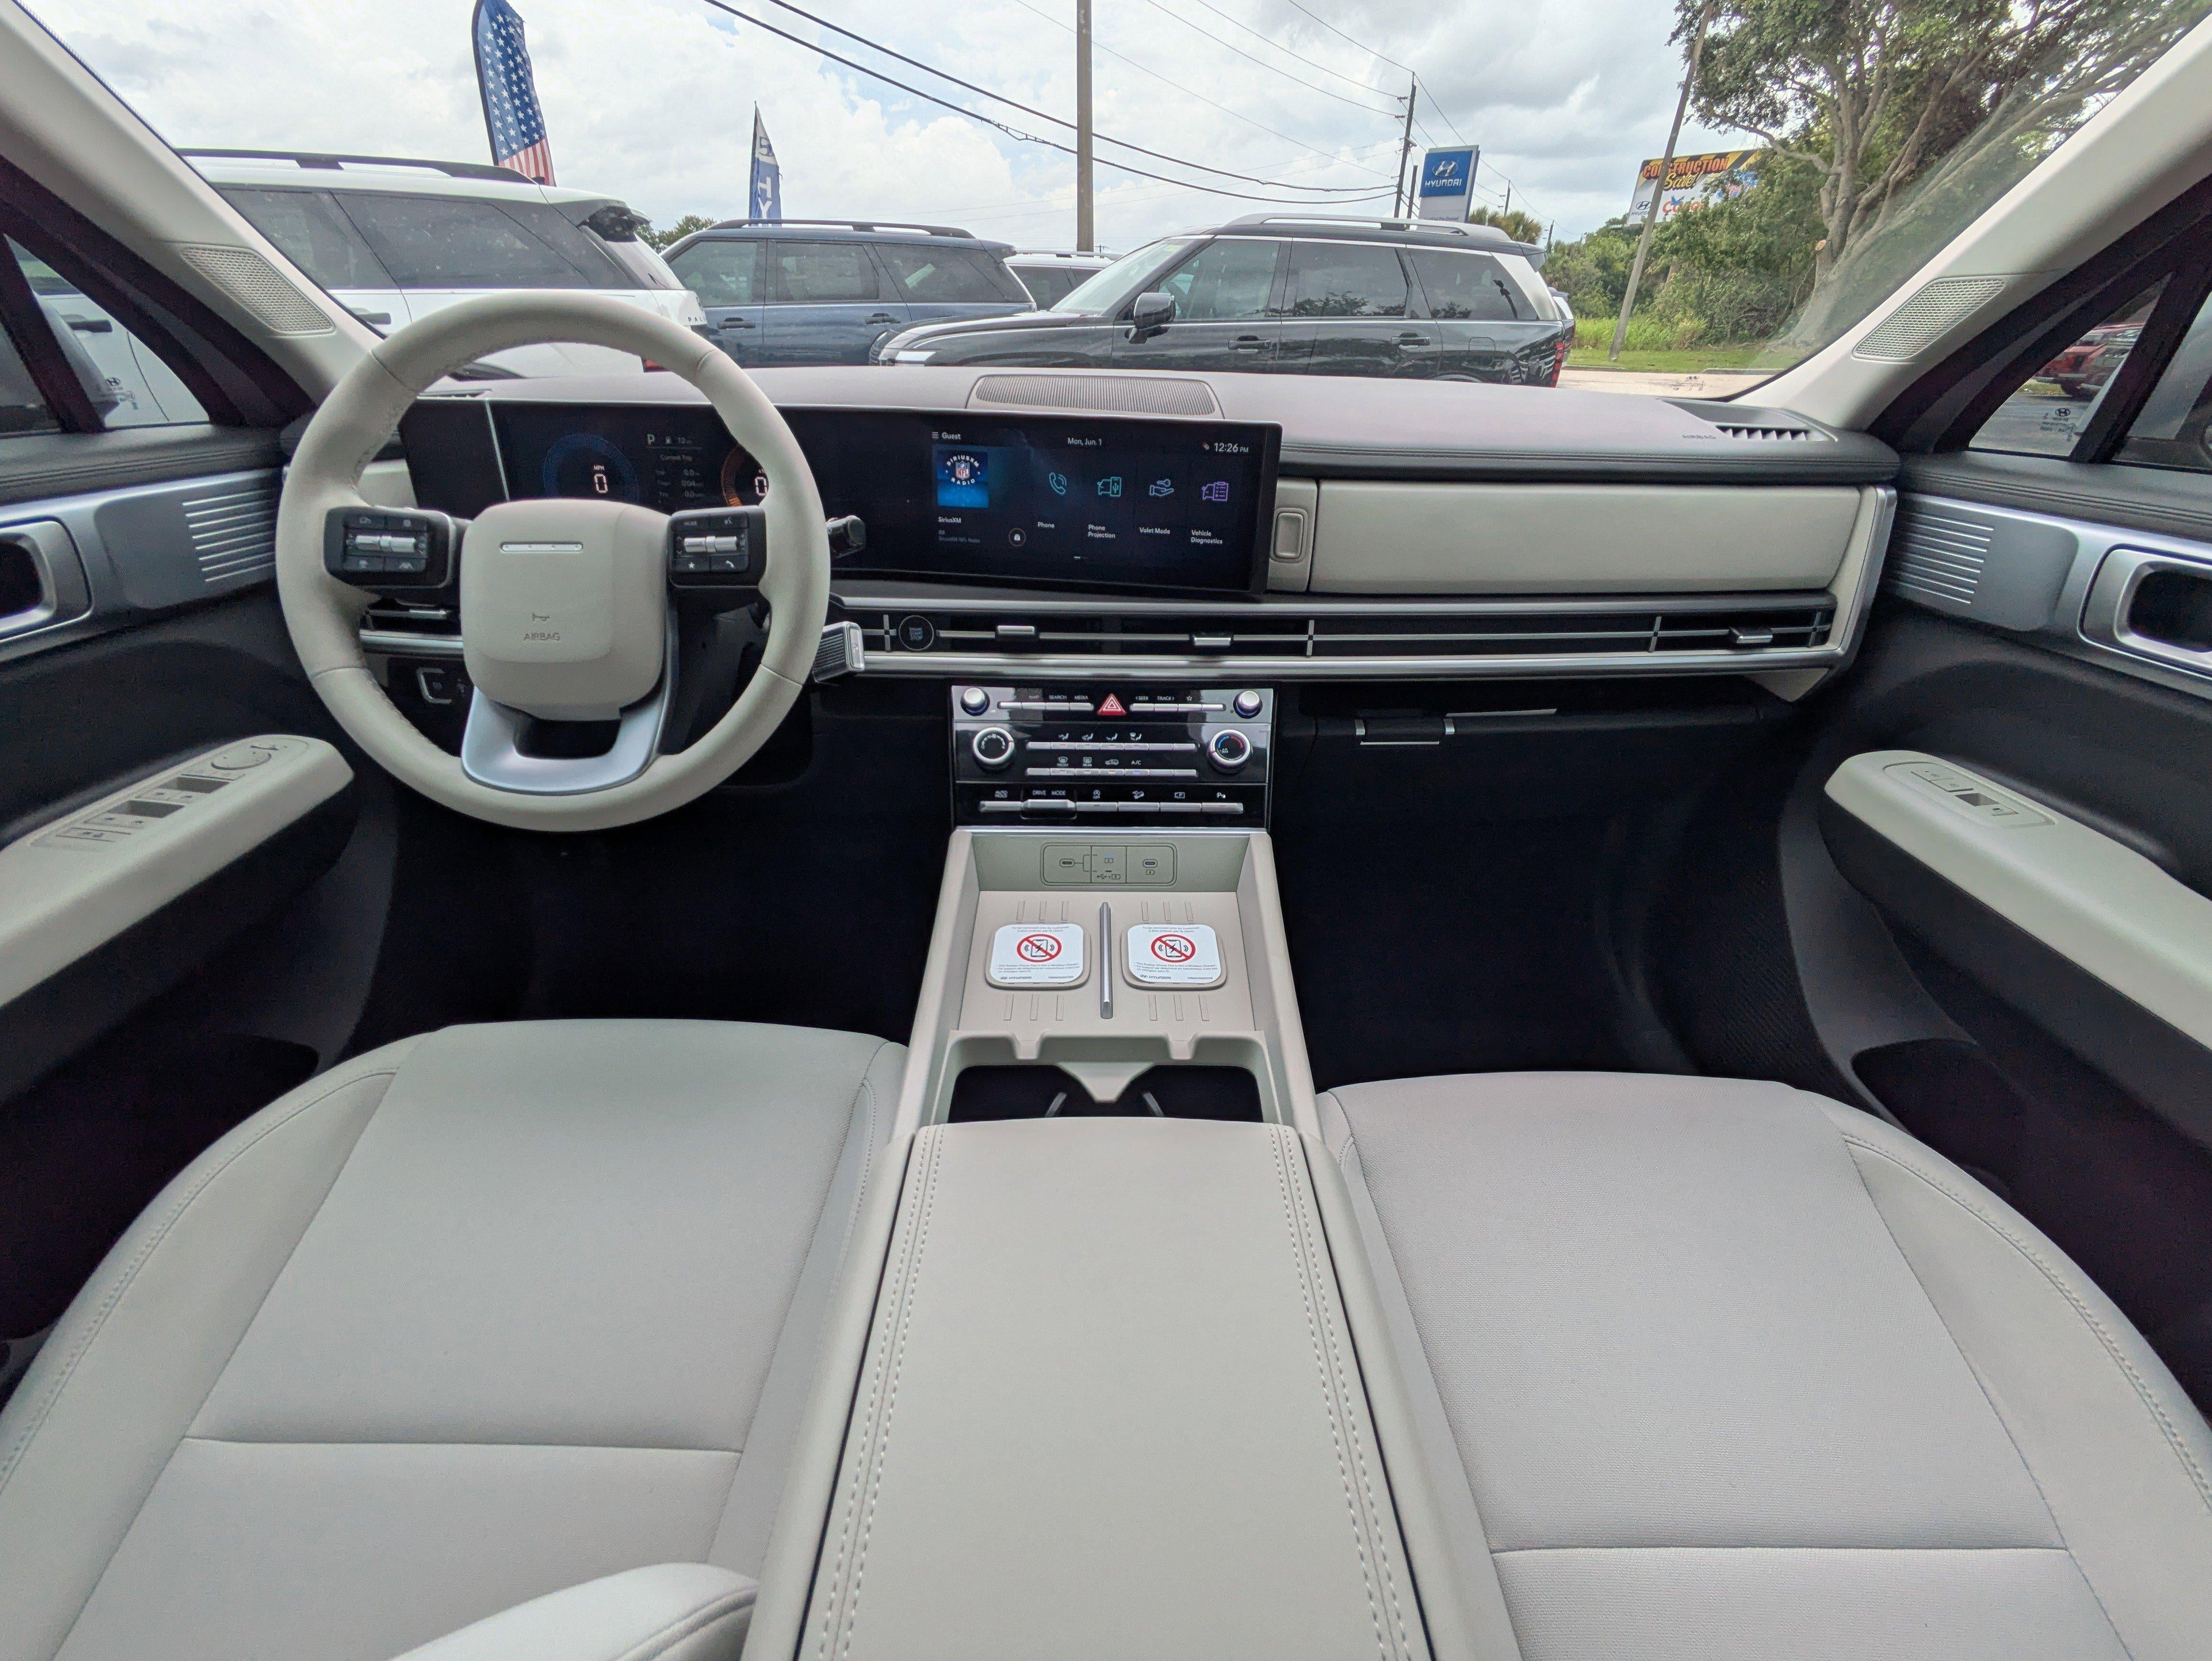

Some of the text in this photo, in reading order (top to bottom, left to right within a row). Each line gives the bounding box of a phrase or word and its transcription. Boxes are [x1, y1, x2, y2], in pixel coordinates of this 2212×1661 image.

[1642, 157, 1730, 179] COTRUCTION
[1425, 178, 1462, 187] HYUNDAI
[1664, 171, 1702, 190] Sale!
[647, 433, 654, 445] P
[941, 432, 961, 440] Guest
[1068, 437, 1084, 446] Mon,
[1215, 443, 1239, 453] 12:26
[958, 469, 969, 477] NFL
[594, 473, 608, 494] 0
[951, 477, 975, 486] RADIO
[523, 632, 560, 641] AIRBAG
